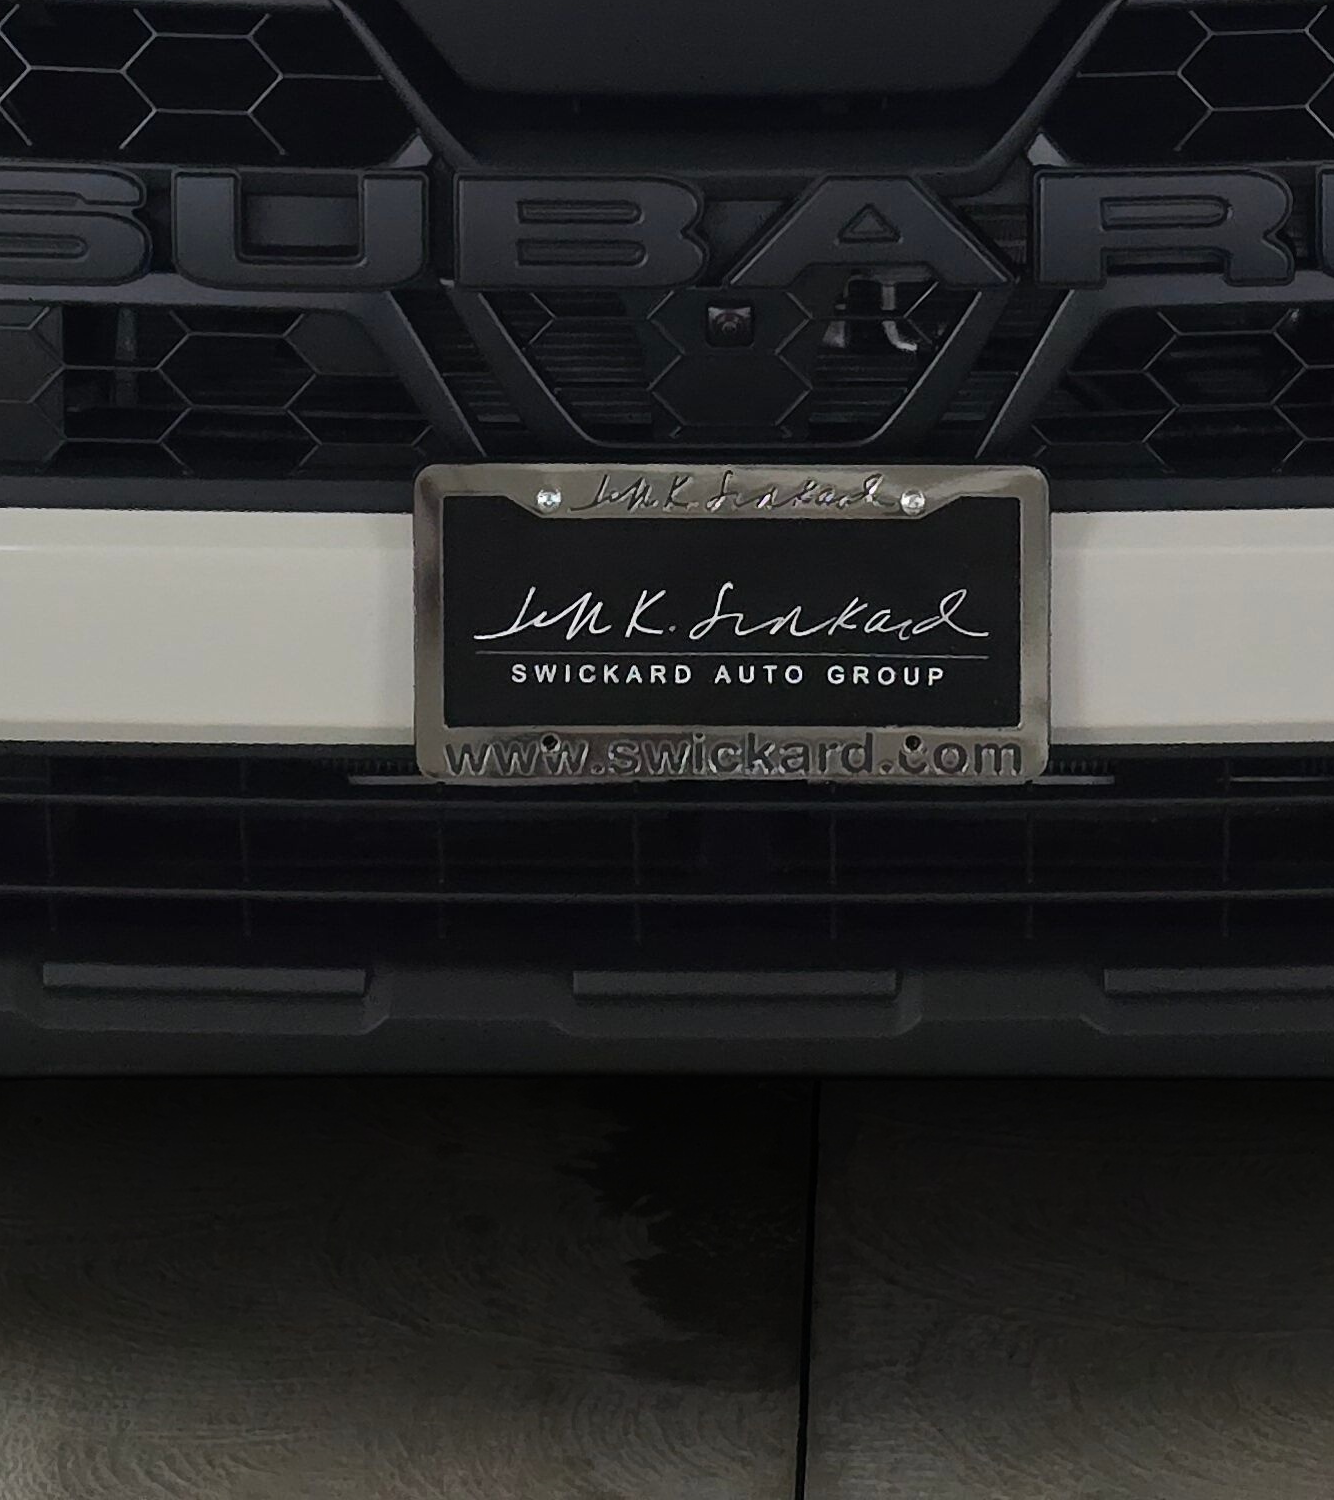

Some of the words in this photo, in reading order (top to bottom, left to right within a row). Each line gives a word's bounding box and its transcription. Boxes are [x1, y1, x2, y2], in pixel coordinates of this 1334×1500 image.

[510, 663, 694, 685] SWICKARD
[714, 664, 805, 685] AUTO
[826, 665, 946, 687] GROUP
[444, 731, 1023, 777] www.swickard.com
